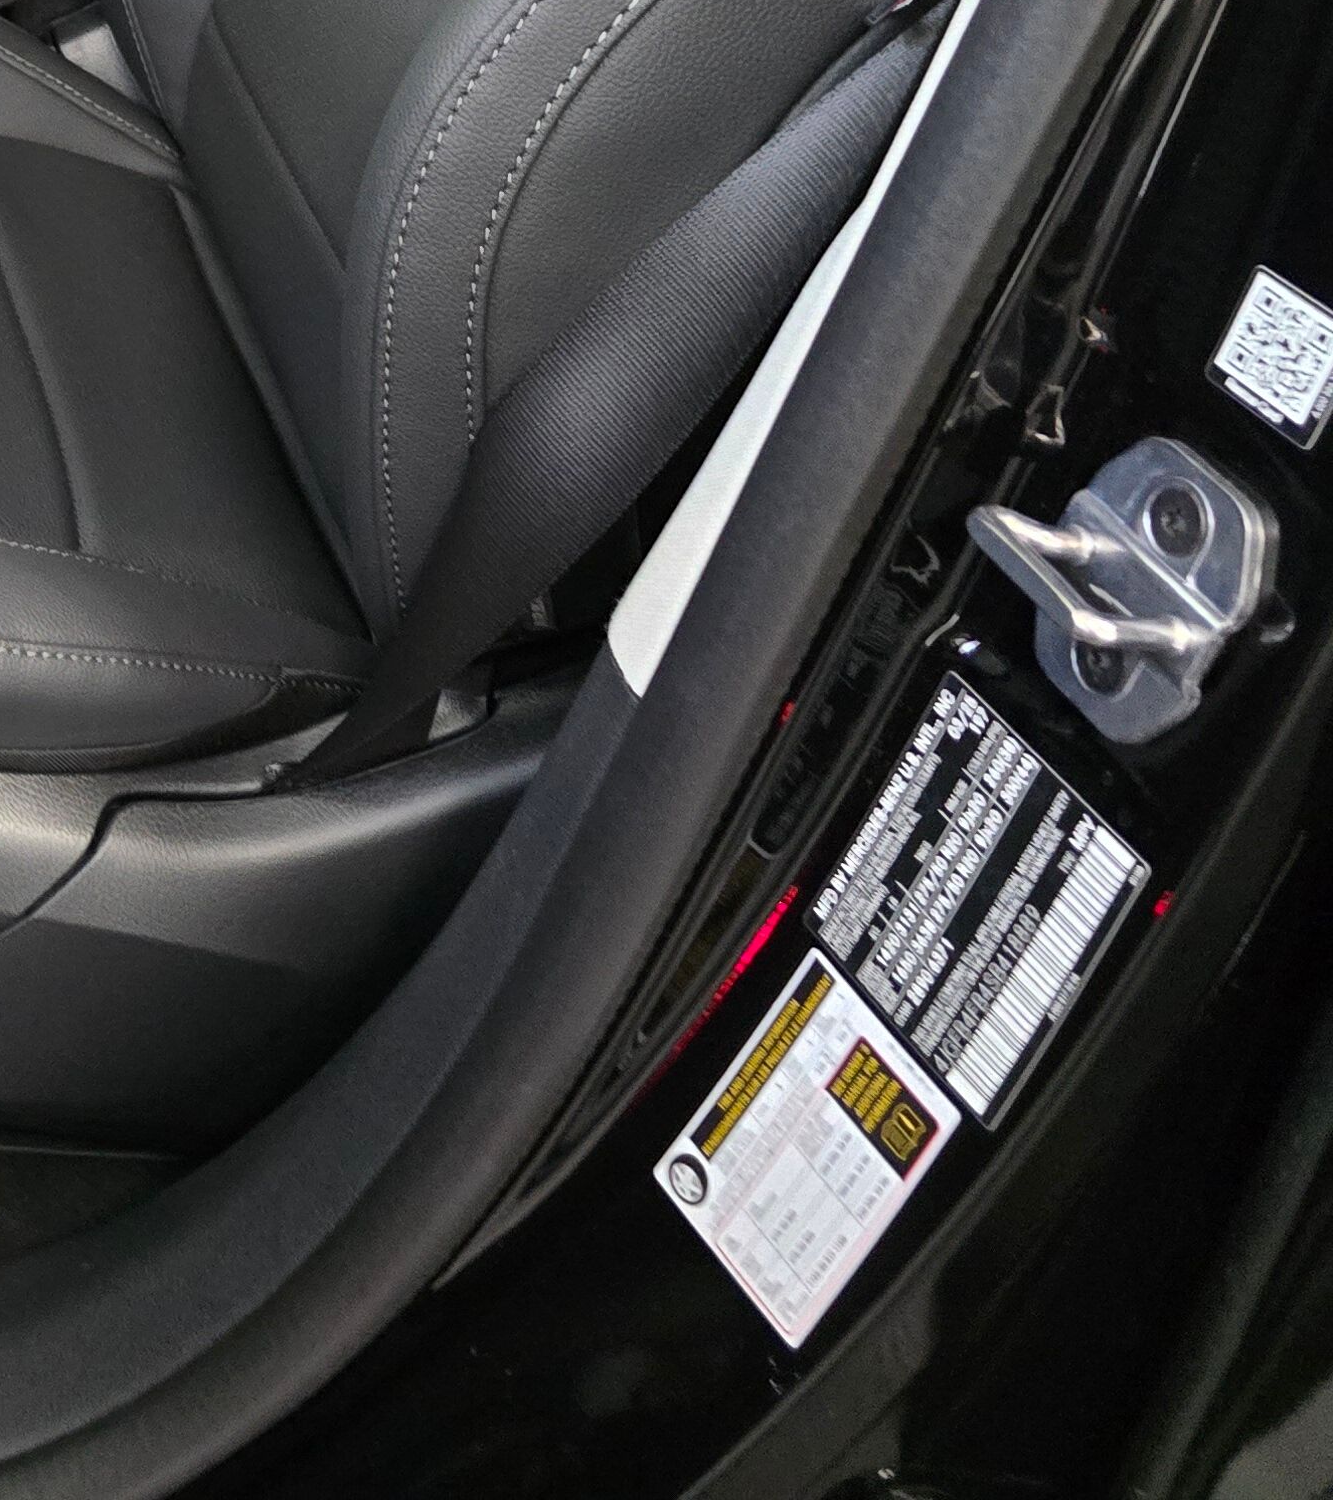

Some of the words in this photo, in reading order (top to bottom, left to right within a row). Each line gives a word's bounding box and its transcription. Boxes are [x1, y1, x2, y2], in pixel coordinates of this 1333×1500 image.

[839, 770, 909, 879] MERCEDES-BENZ
[1066, 812, 1099, 854] MPV
[829, 866, 850, 894] BY
[812, 883, 840, 923] MFD
